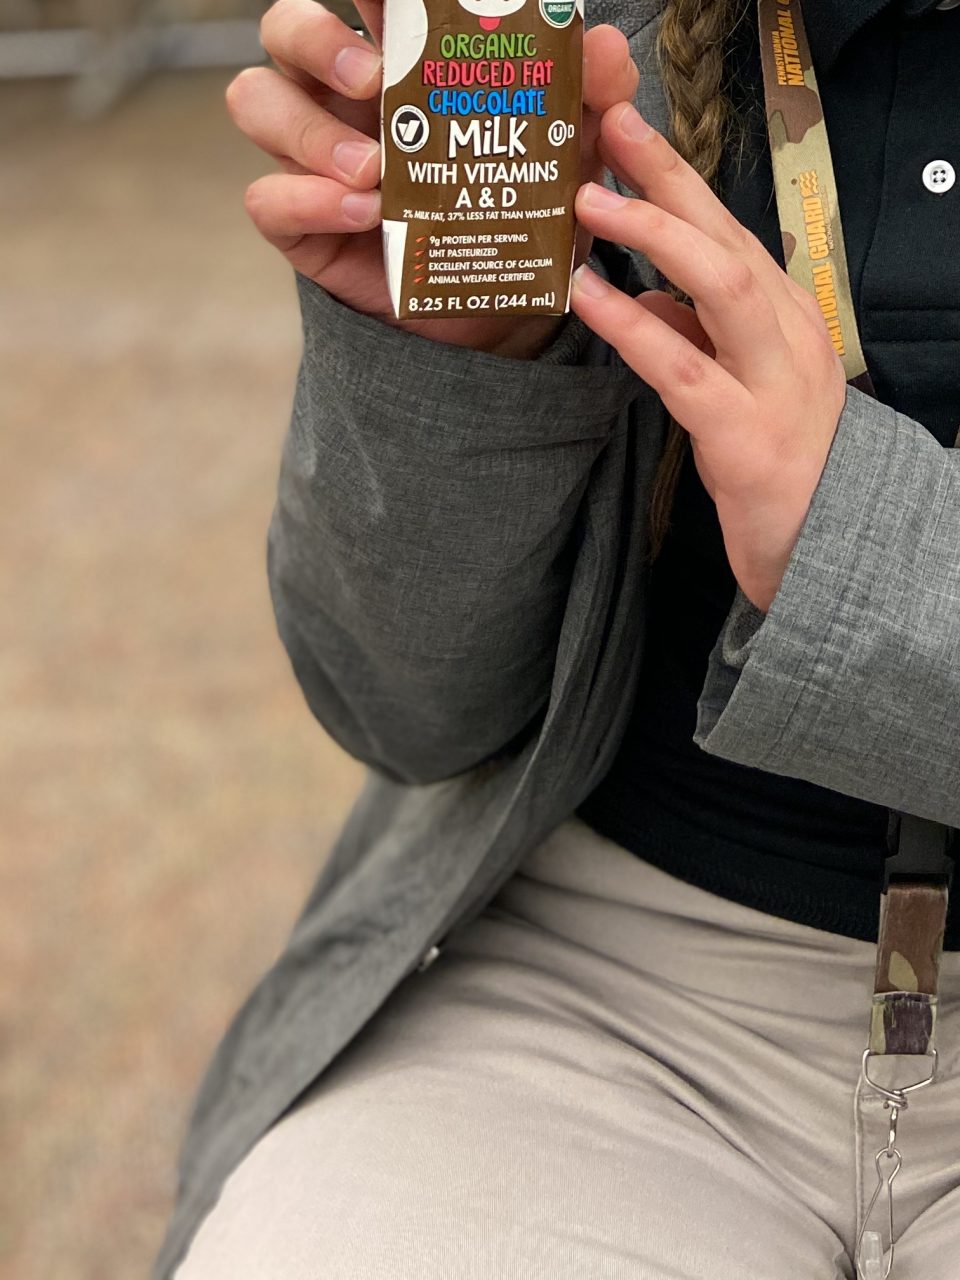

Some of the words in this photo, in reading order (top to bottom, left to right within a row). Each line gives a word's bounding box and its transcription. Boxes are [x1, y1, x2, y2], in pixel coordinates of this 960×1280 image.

[548, 4, 573, 13] ORGANIC
[440, 33, 537, 59] ORGANIC
[777, 9, 805, 86] NATIONAL
[772, 30, 787, 86] PENNSYLVANIA
[422, 60, 516, 87] REDUCED
[522, 58, 554, 86] FAT
[428, 88, 547, 116] CHOCOLATE
[407, 161, 457, 185] WITH
[464, 160, 559, 184] VITAMINS
[455, 187, 472, 208] A
[478, 187, 495, 208] &
[502, 188, 517, 208] D
[403, 209, 413, 218] 2%
[414, 210, 430, 220] MILK
[431, 212, 445, 222] FAT,
[448, 212, 465, 221] 37%
[467, 211, 485, 220] LESS
[486, 211, 499, 220] FAT
[501, 211, 524, 219] THAN
[525, 208, 551, 219] WHOLE
[551, 206, 566, 216] MILK
[802, 197, 830, 260] GUARD
[429, 236, 440, 246] 9g
[442, 235, 477, 245] PROTEIN
[478, 234, 492, 244] PER
[494, 234, 528, 244] SERVING
[429, 249, 445, 258] UHT
[447, 248, 498, 257] PASTEURIZED
[428, 261, 470, 271] EXCELLENT
[472, 261, 503, 270] SOURCE
[505, 260, 517, 269] OF
[518, 258, 553, 268] CALCIUM
[428, 275, 460, 284] ANIMAL
[462, 274, 497, 283] WELFARE
[499, 272, 535, 282] CERTIFIED
[408, 297, 443, 311] 8.25
[447, 296, 463, 310] FL
[466, 295, 490, 309] OZ
[495, 294, 527, 310] (244
[531, 292, 555, 308] mL)
